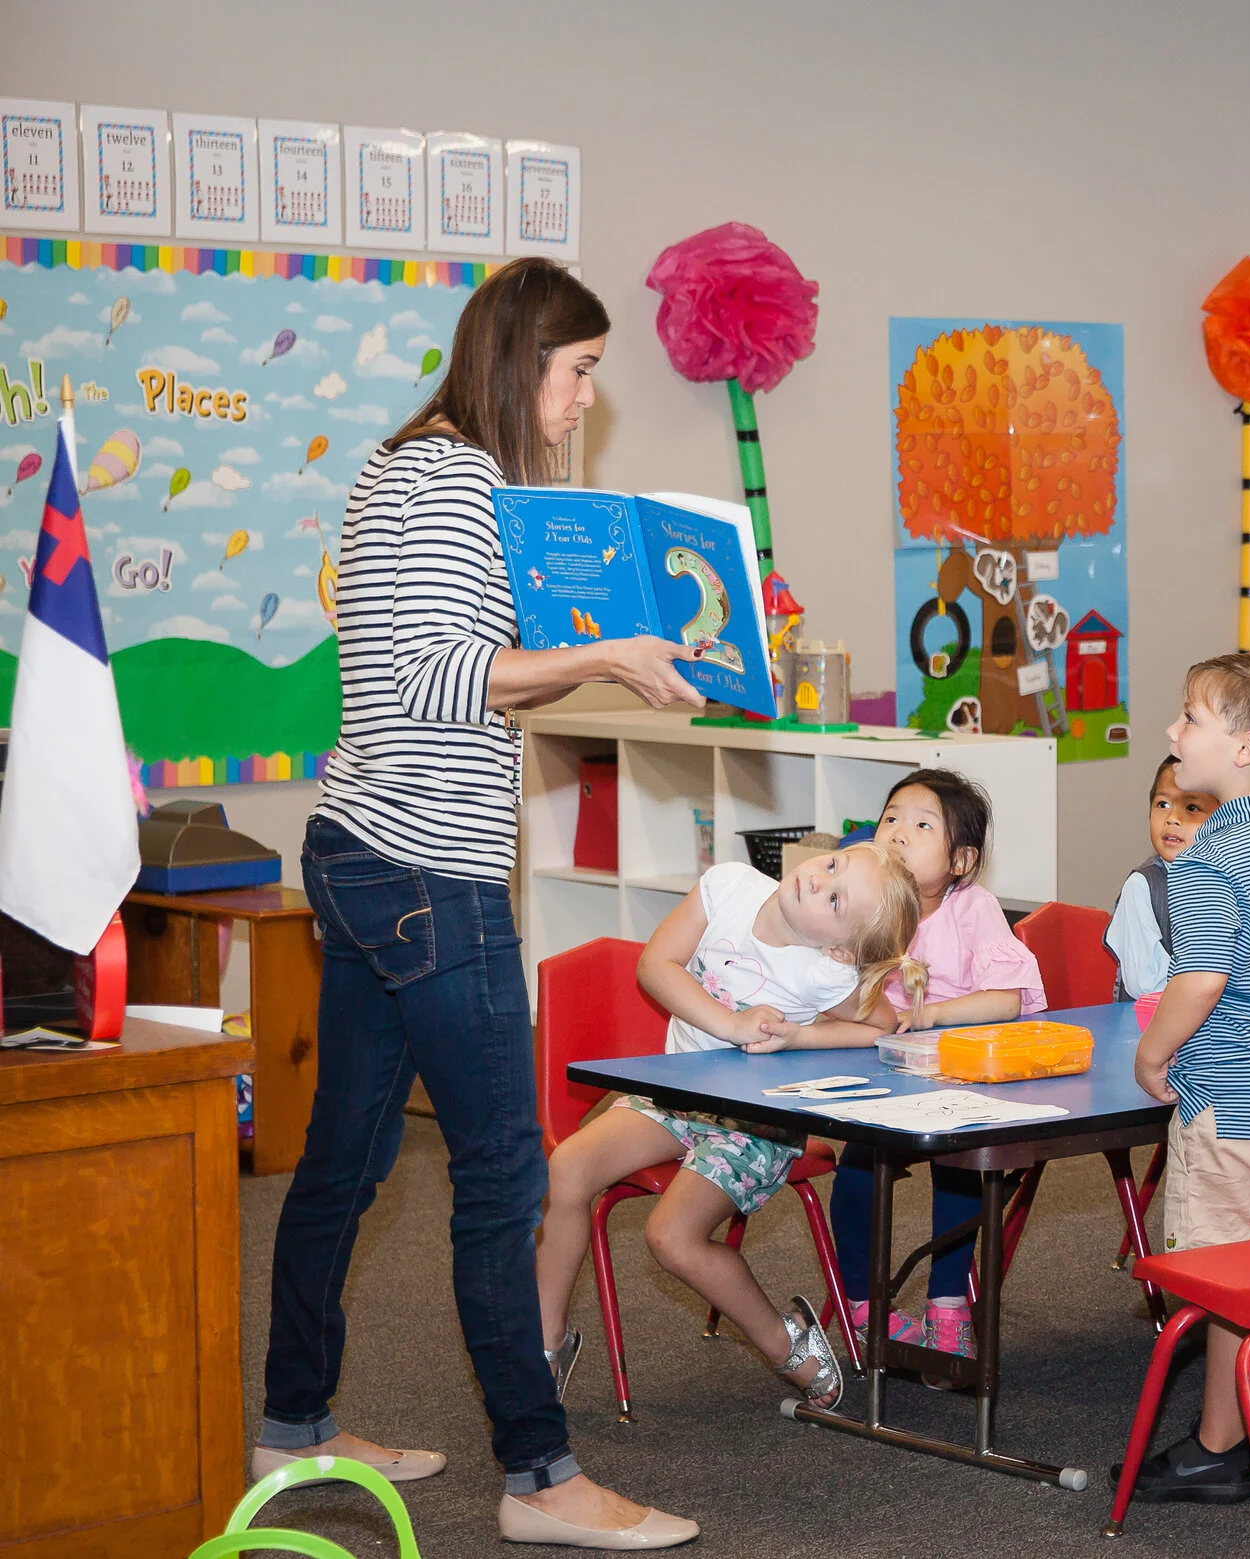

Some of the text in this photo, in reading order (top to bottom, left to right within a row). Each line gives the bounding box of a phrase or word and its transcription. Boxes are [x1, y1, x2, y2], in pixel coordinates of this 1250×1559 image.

[11, 122, 53, 140] eleven
[106, 129, 147, 147] twelve
[195, 135, 238, 151] thirteen
[279, 142, 324, 157] fourteen
[29, 153, 39, 166] 11
[449, 158, 485, 171] sixteen
[122, 160, 134, 173] 12
[212, 164, 223, 176] 13
[297, 170, 308, 182] 14
[381, 176, 392, 189] 15
[462, 182, 473, 194] 16
[540, 188, 551, 199] 17
[0, 361, 248, 425] h! The Places
[546, 521, 585, 532] Stories for
[551, 531, 570, 542] Year
[572, 534, 592, 544] Olds
[661, 520, 698, 546] Stories
[700, 532, 716, 552] for
[114, 549, 173, 591] Go!
[717, 672, 746, 694] Olds
